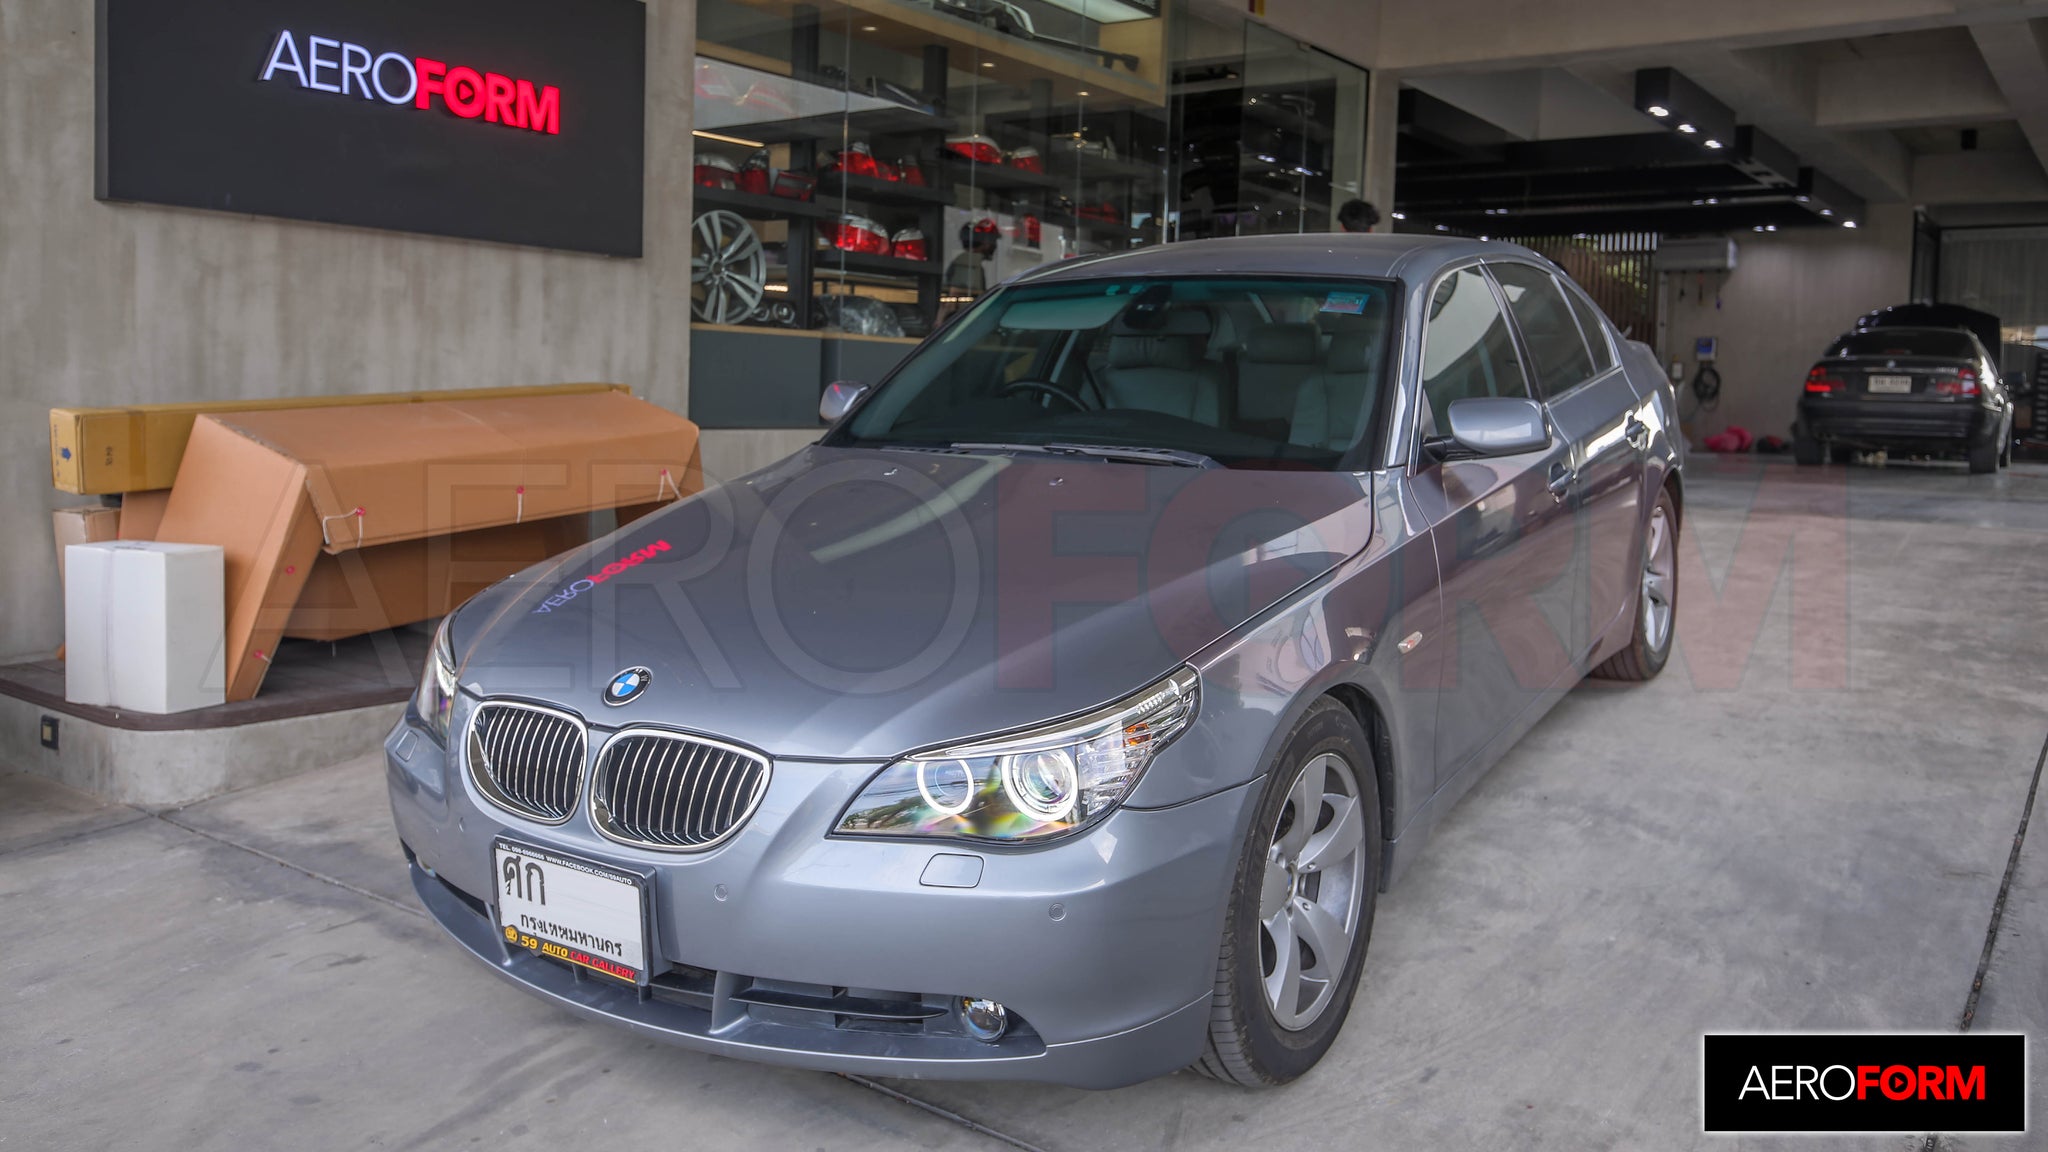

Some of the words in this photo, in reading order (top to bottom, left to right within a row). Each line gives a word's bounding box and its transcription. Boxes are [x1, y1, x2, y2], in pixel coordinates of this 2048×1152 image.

[259, 29, 560, 135] AEROFORM
[520, 914, 622, 957] กรุงเทพมหานคร
[520, 935, 538, 950] 59
[541, 942, 569, 958] AUTO
[569, 950, 590, 965] CAR
[592, 957, 635, 980] GALLERY
